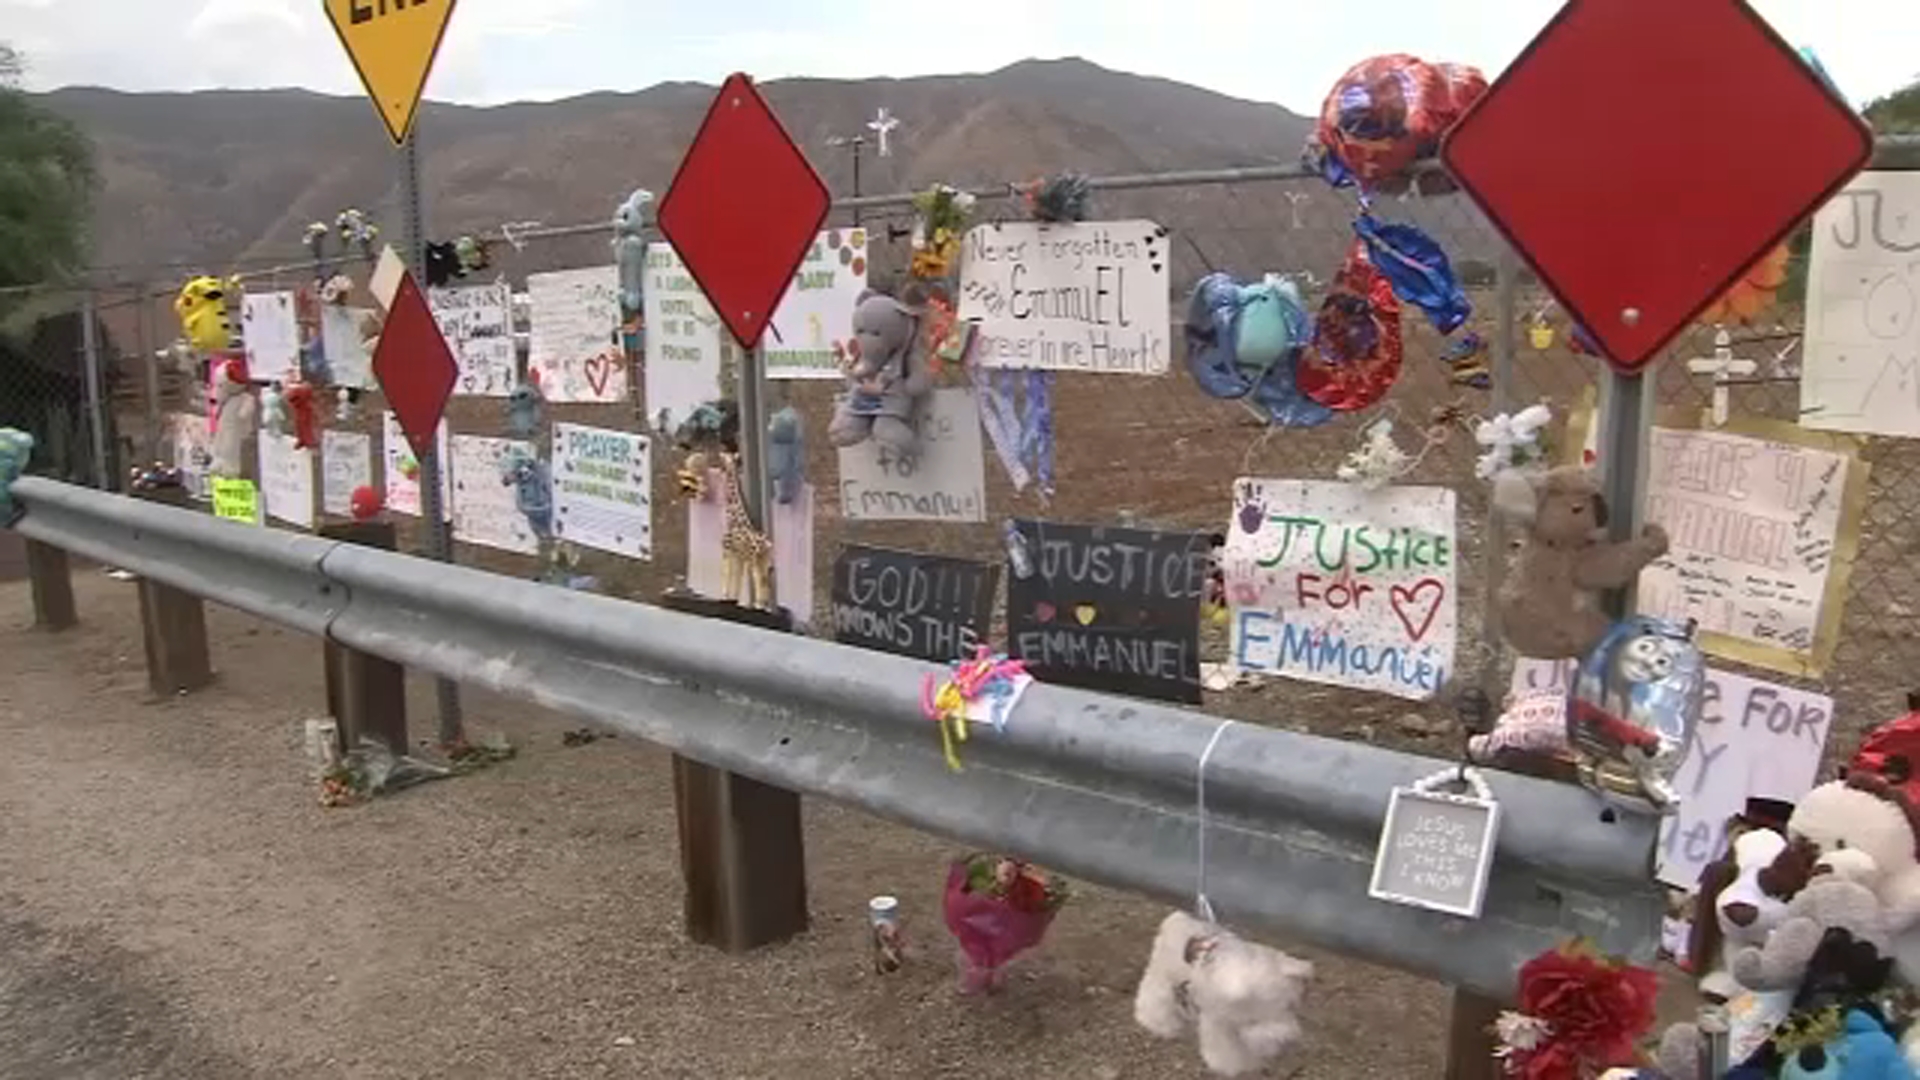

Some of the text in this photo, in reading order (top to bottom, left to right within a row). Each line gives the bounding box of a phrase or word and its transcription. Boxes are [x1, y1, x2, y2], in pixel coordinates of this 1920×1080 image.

[971, 227, 1139, 270] Never Forgotten
[568, 430, 632, 463] PRAYER
[1040, 536, 1202, 597] JUSTICE
[921, 616, 977, 660] THE
[1018, 630, 1202, 684] EMMANUEL
[1741, 687, 1826, 748] FOR
